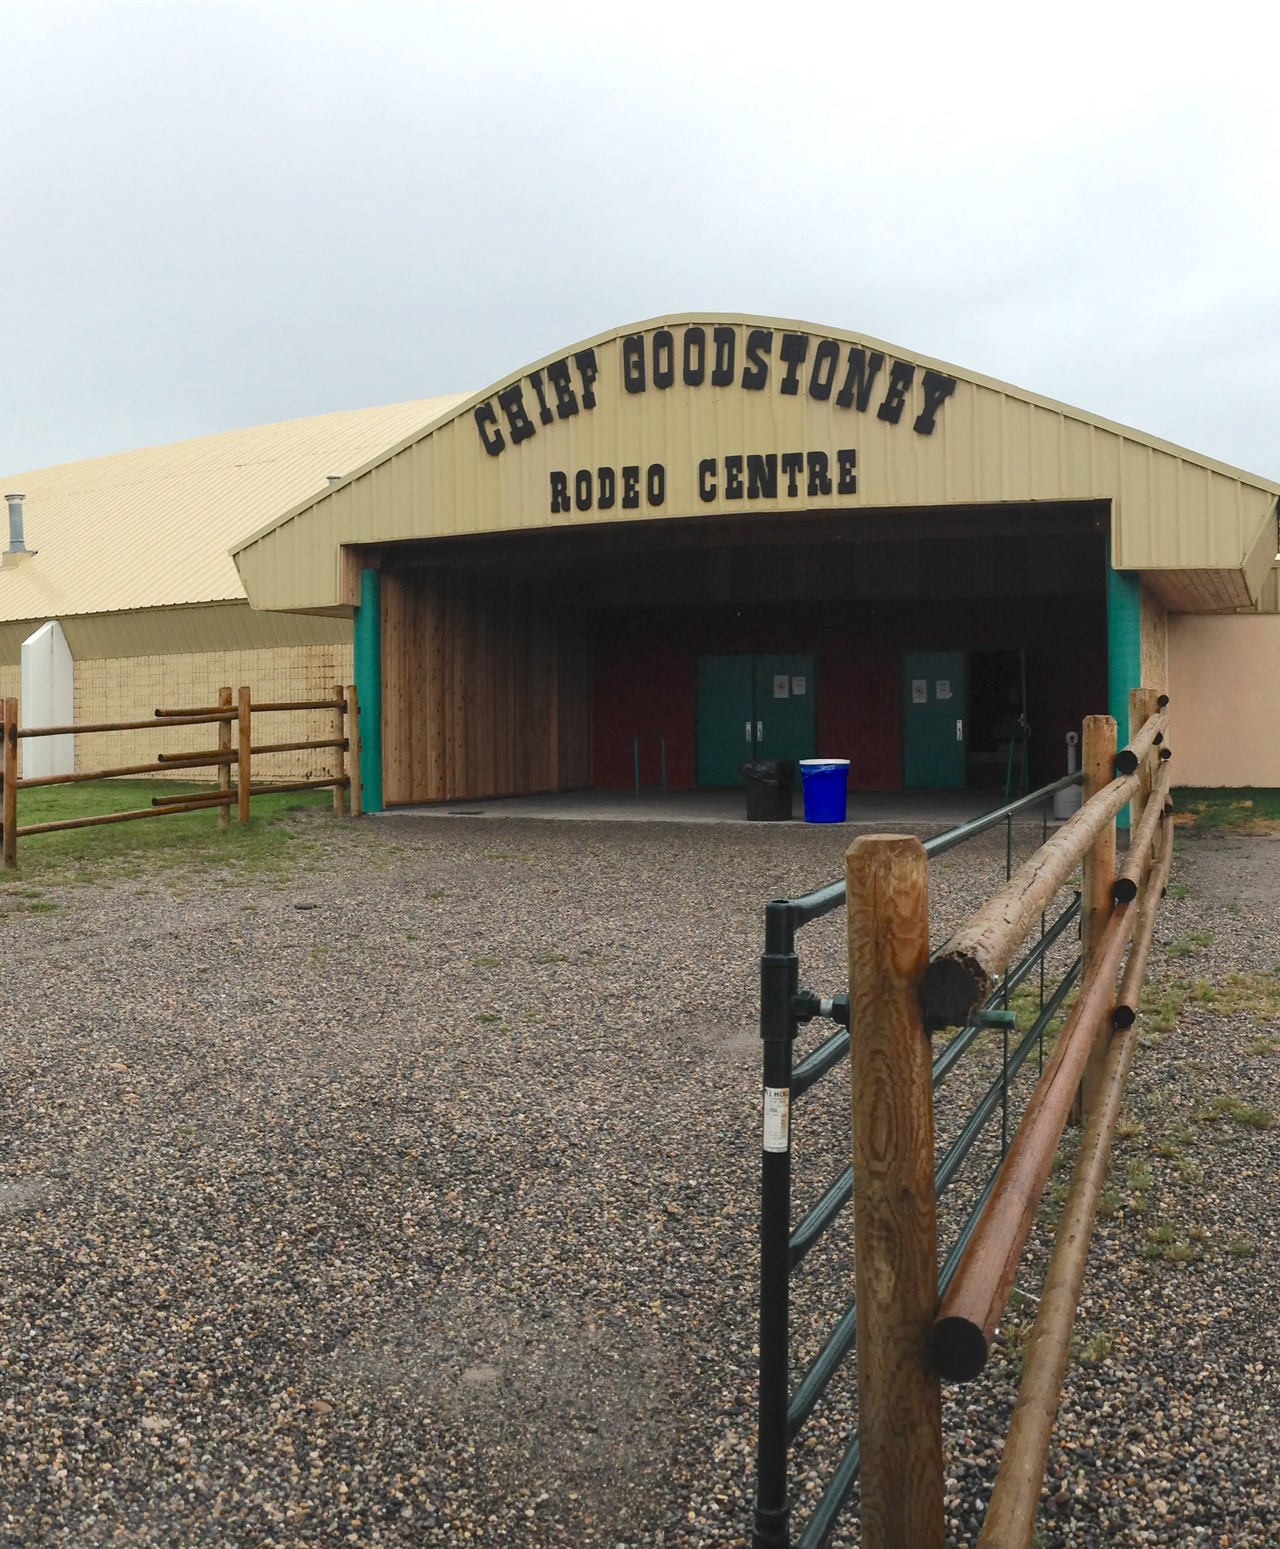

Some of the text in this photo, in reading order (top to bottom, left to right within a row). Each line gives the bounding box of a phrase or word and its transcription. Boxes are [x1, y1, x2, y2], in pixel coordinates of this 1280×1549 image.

[473, 326, 957, 457] CHIEF GOODSTONEY
[549, 448, 858, 514] RODEO CENTRE
